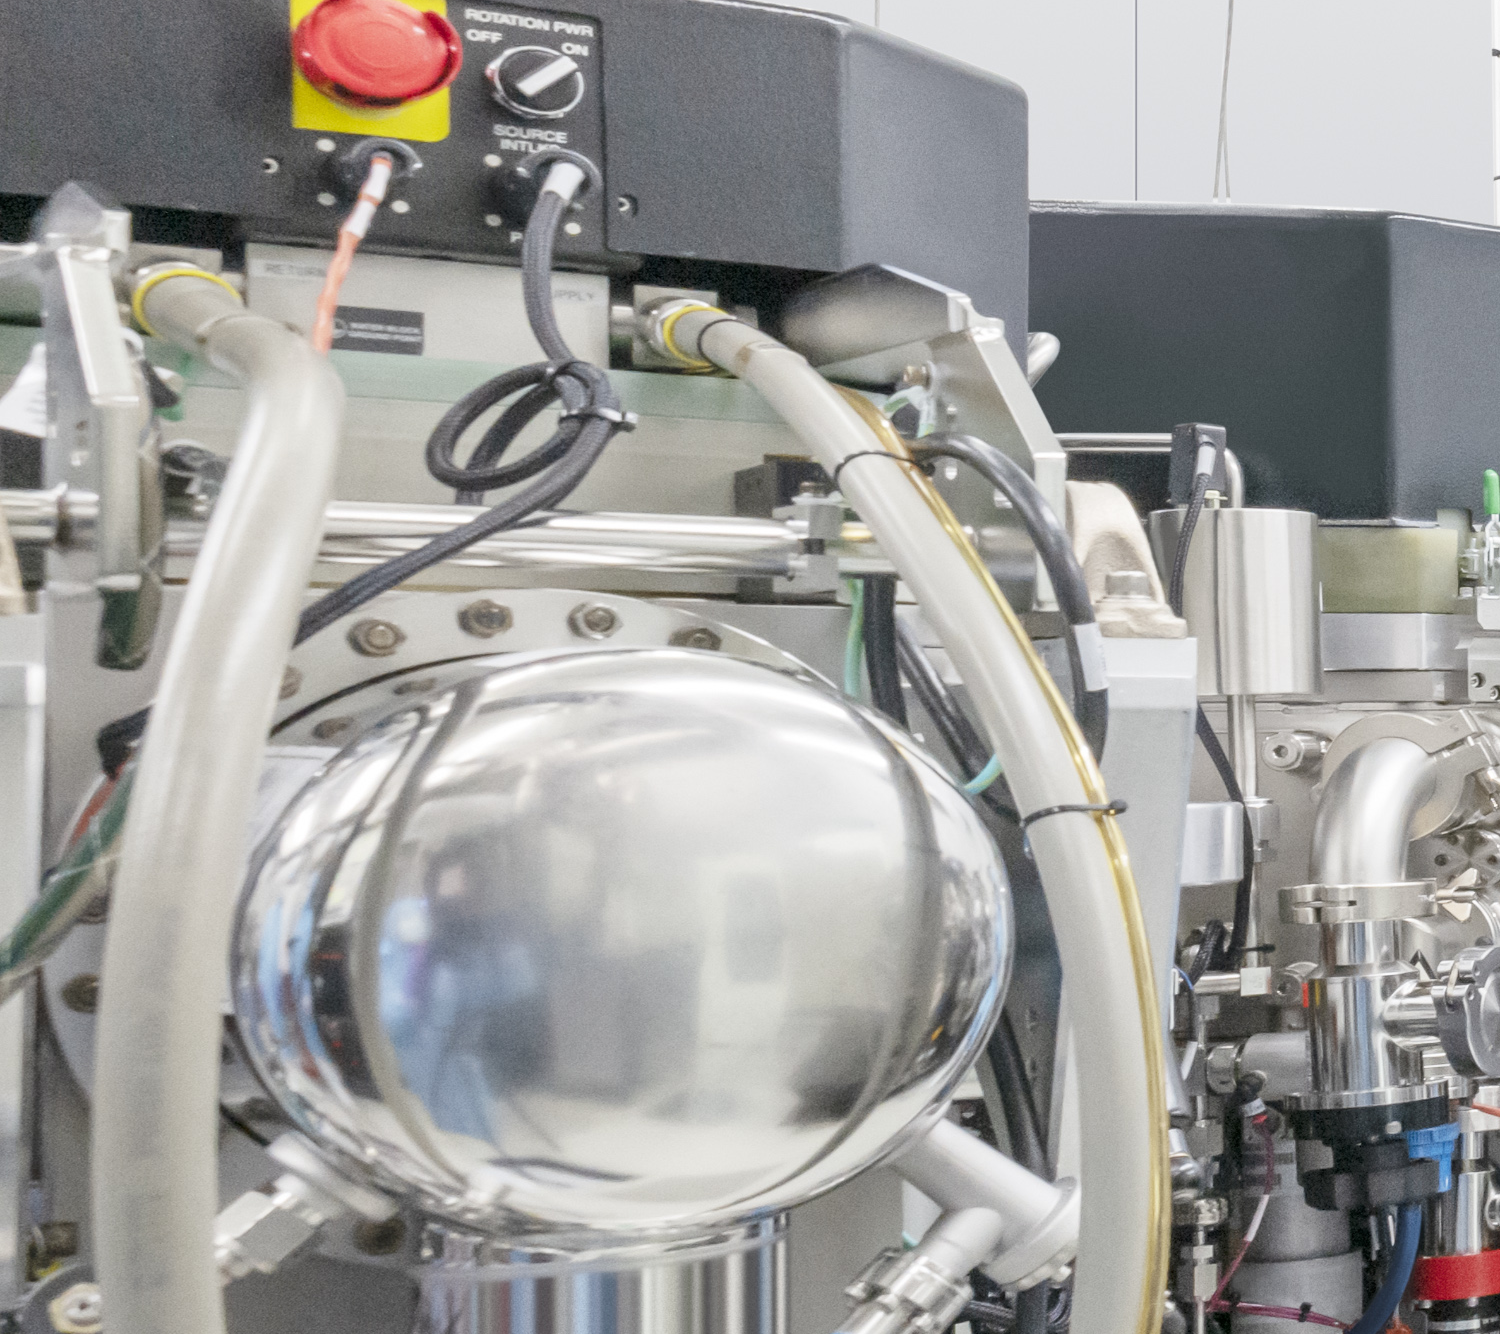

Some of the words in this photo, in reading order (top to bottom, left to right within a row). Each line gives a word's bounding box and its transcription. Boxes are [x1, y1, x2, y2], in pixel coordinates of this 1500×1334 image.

[464, 8, 550, 31] ROTATION
[553, 21, 594, 38] PWR
[465, 28, 503, 43] OFF
[561, 41, 589, 56] ON
[493, 123, 568, 144] SOURCE
[500, 139, 555, 153] INTLK
